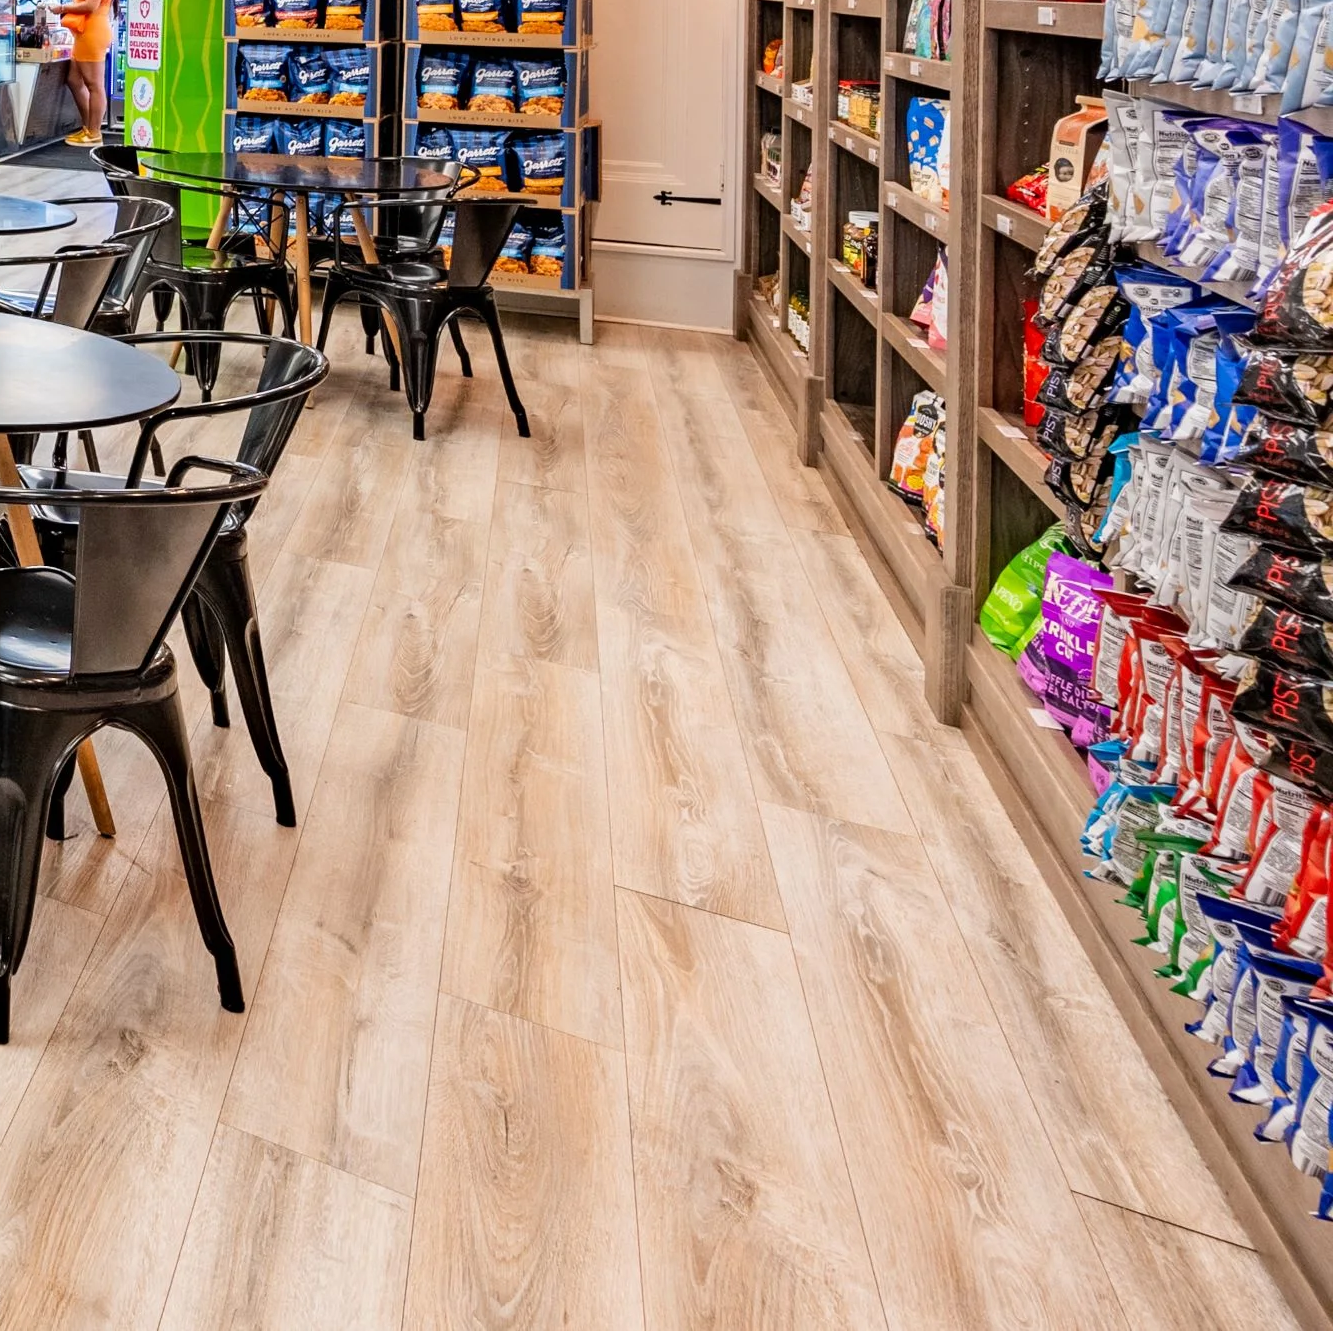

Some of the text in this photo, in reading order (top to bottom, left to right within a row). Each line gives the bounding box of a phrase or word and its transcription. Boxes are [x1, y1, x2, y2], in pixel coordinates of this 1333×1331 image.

[130, 22, 159, 31] NATURAL
[130, 30, 159, 39] BENEFITS
[130, 41, 159, 49] DELICIOUS
[130, 48, 159, 60] TASTE
[422, 66, 460, 81] Garrett
[475, 68, 515, 83] Garrett
[520, 66, 561, 86] Garrett
[233, 134, 269, 152] Garrett
[288, 136, 321, 155] Garrett
[328, 136, 366, 153] Garrett
[457, 146, 500, 162] Garrett
[523, 157, 565, 174] Garrett
[1042, 617, 1095, 657] KRINKLE
[1055, 641, 1075, 663] CUT
[1146, 660, 1176, 672] Nutritio
